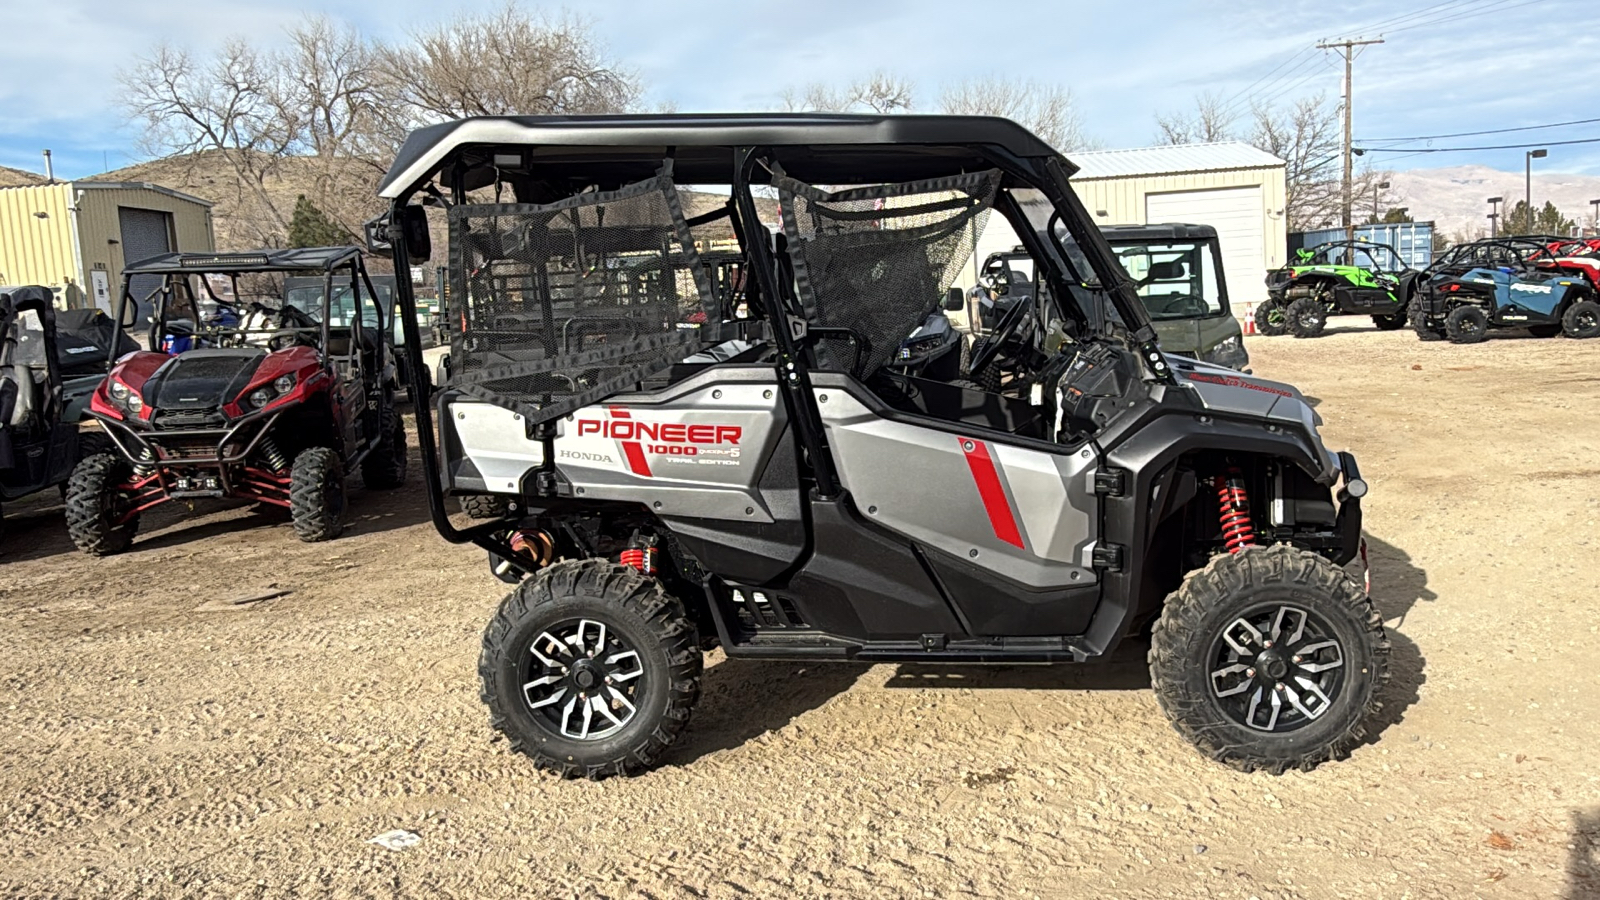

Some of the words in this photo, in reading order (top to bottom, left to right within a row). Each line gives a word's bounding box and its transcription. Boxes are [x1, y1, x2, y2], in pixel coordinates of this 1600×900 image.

[578, 419, 742, 445] PIONEER
[560, 449, 614, 463] HONDA
[647, 444, 698, 456] 1000
[666, 456, 697, 464] TRAIL
